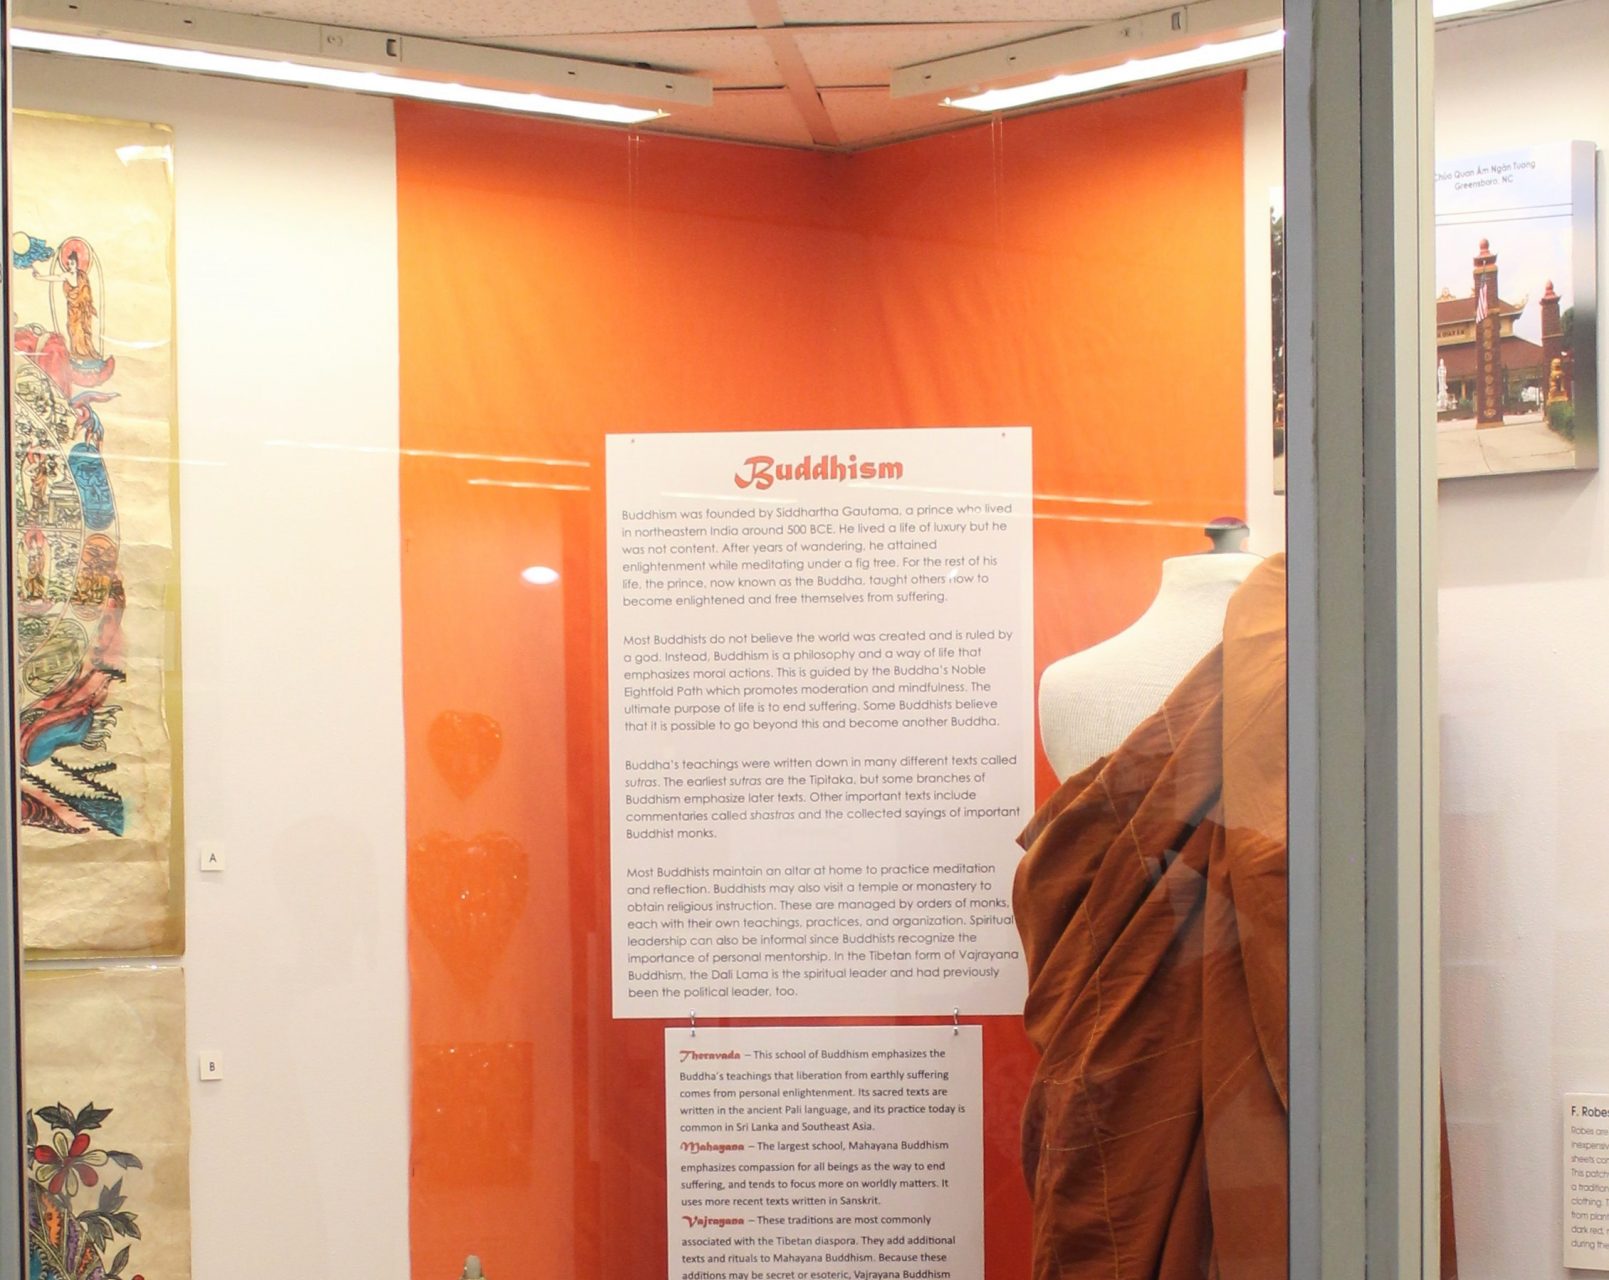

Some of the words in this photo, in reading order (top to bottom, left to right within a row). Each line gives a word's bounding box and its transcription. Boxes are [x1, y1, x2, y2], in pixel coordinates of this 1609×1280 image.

[734, 454, 904, 490] Buddhism
[622, 509, 678, 520] Buddhism
[679, 511, 703, 519] was
[705, 508, 756, 519] founded
[758, 508, 774, 519] by
[775, 506, 839, 517] Siddhartha
[905, 507, 914, 515] a
[916, 504, 954, 517] prince
[956, 504, 982, 513] who
[984, 503, 1013, 513] lived
[624, 686, 674, 699] Eightfold
[676, 685, 703, 696] Path
[705, 685, 741, 695] which
[743, 684, 798, 697] promotes
[800, 683, 869, 694] moderation
[871, 682, 896, 693] and
[898, 682, 968, 692] mindfulness.
[970, 681, 991, 691] The
[626, 828, 674, 839] Buddhist
[677, 827, 717, 838] monks.
[209, 853, 217, 863] A
[628, 987, 659, 997] been
[661, 987, 681, 997] the
[683, 986, 729, 998] political
[775, 986, 798, 996] too.
[753, 1050, 773, 1059] This
[775, 1049, 806, 1059] school
[808, 1049, 819, 1058] of
[821, 1049, 869, 1058] Buddhism
[871, 1049, 927, 1060] emphasizes
[929, 1048, 946, 1057] the
[209, 1061, 216, 1072] B
[680, 1141, 745, 1154] Mahayana
[757, 1141, 775, 1150] The
[777, 1141, 810, 1152] largest
[848, 1140, 899, 1151] Mahayana
[901, 1140, 949, 1149] Buddhism
[681, 1215, 745, 1228] Vajrayana
[757, 1215, 786, 1224] These
[787, 1215, 834, 1224] traditions
[835, 1216, 852, 1224] are
[854, 1216, 878, 1224] most
[880, 1214, 932, 1225] commonly
